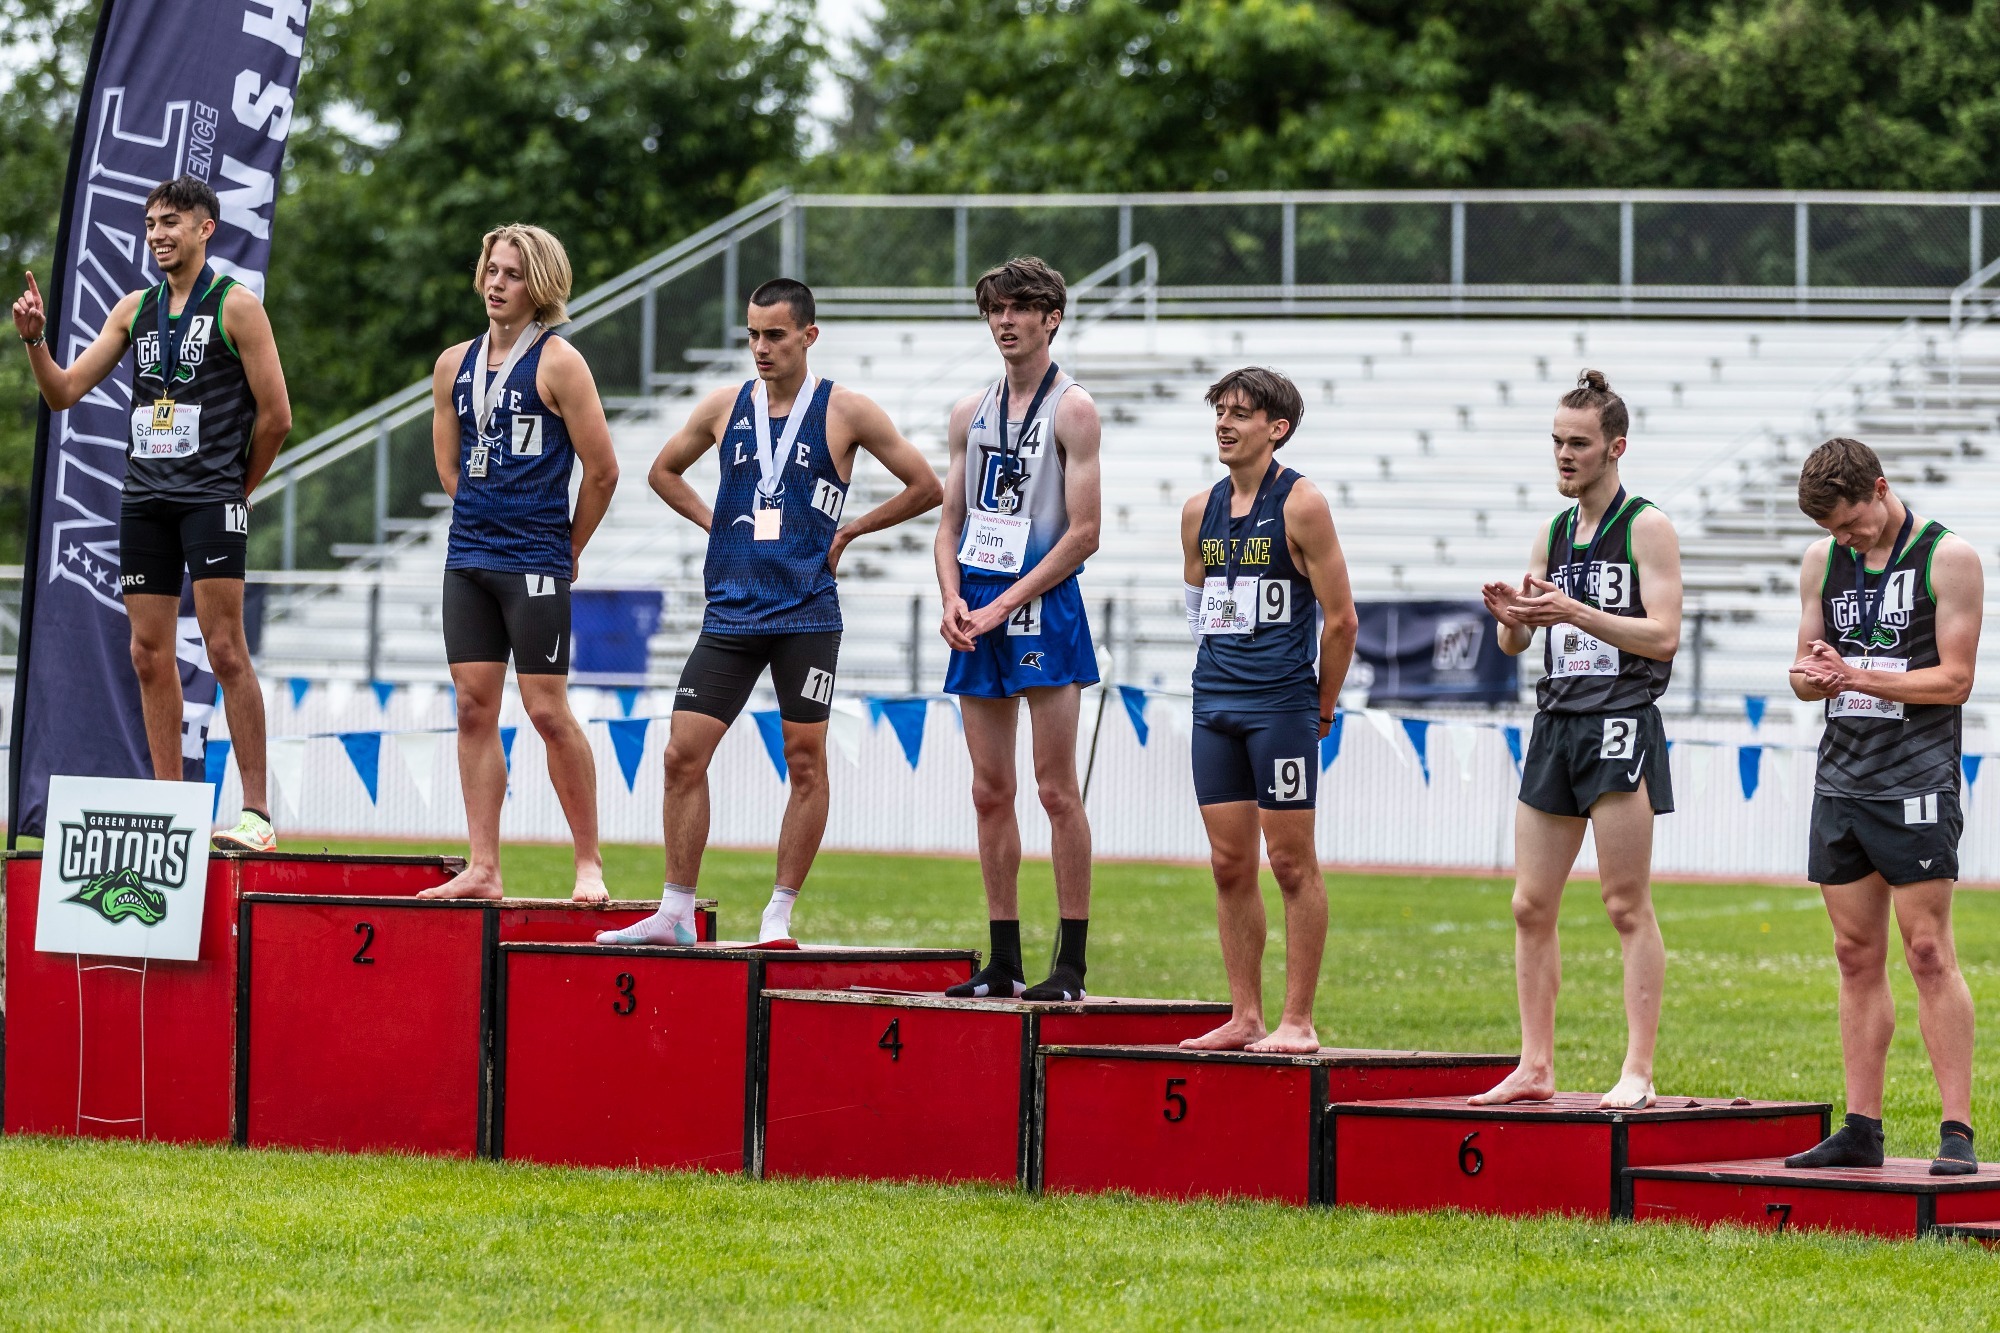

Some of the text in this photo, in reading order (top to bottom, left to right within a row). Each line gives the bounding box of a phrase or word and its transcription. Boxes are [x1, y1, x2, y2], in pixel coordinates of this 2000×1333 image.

[140, 340, 201, 364] GARS
[458, 387, 522, 417] LNE
[151, 443, 172, 454] 2023
[517, 417, 536, 453] 7
[1022, 421, 1041, 455] 4
[733, 438, 811, 469] LE
[822, 484, 840, 517] 11
[231, 503, 247, 532] 12
[975, 530, 1004, 548] Holm
[977, 551, 996, 564] 2023
[121, 574, 146, 586] GRC
[1605, 566, 1623, 606] 3
[1892, 572, 1906, 610] 1
[1265, 581, 1285, 621] 9
[1011, 601, 1035, 633] 4
[1210, 618, 1231, 628] 2023
[1575, 637, 1598, 652] cks
[1568, 660, 1591, 672] 2023
[812, 672, 831, 702] 11
[1847, 698, 1873, 710] 2023
[1606, 720, 1629, 757] 3
[1281, 760, 1300, 799] 9
[89, 815, 164, 829] GREEN RIVER
[62, 827, 188, 884] GATORS
[352, 922, 374, 964] 2
[613, 972, 636, 1015] 3
[878, 1017, 903, 1061] 4
[1163, 1077, 1187, 1123] 5
[1457, 1130, 1484, 1177] 6
[1765, 1203, 1792, 1232] 7
